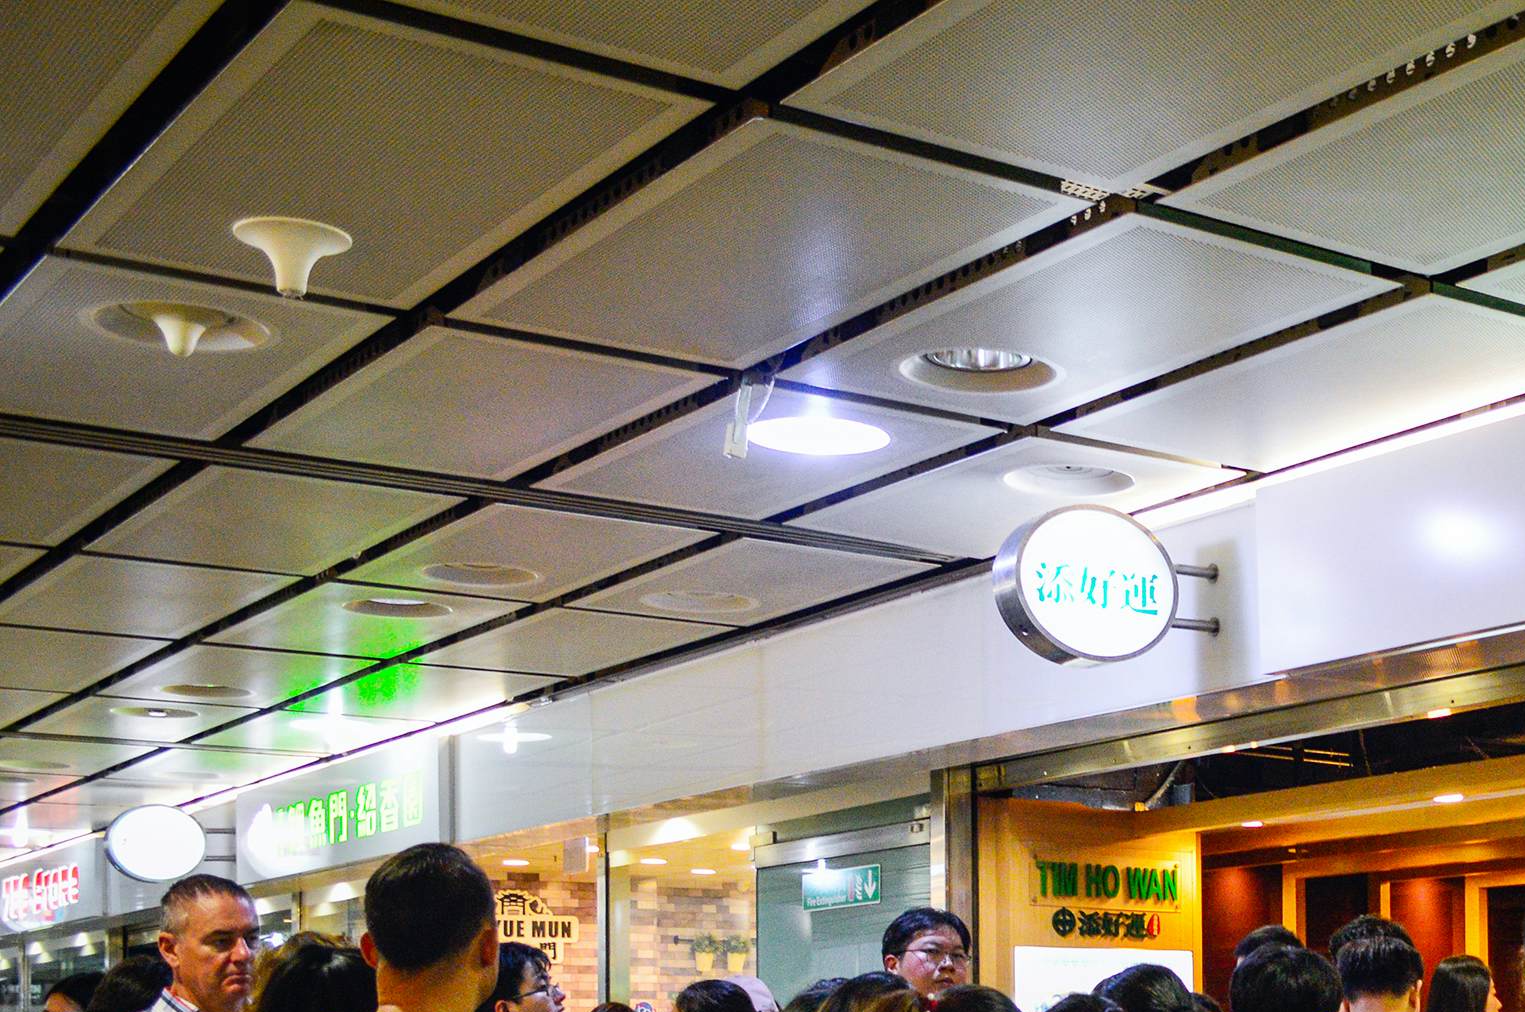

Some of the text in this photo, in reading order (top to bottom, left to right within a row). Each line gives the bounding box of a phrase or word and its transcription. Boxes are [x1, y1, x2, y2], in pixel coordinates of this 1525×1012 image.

[1035, 562, 1158, 615] 添好運
[1035, 860, 1178, 902] TIM HO WAN
[498, 920, 572, 939] UE MUN
